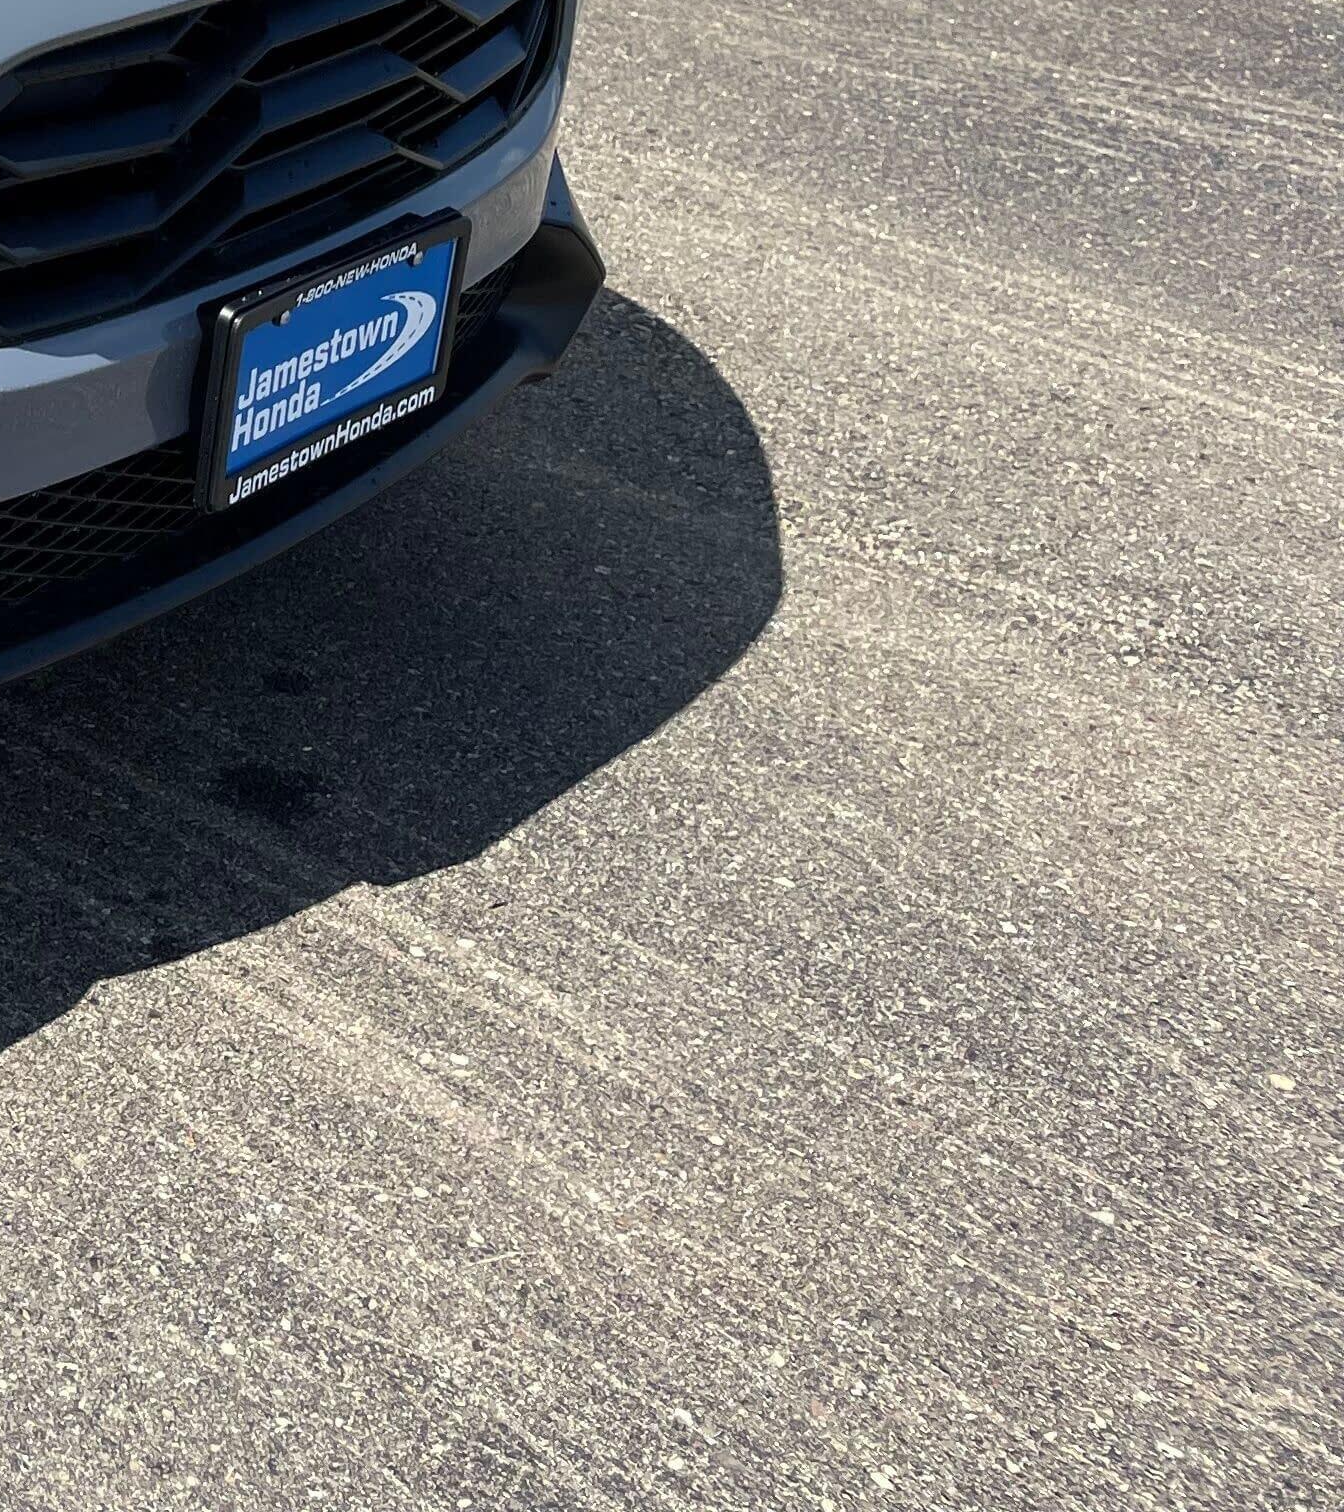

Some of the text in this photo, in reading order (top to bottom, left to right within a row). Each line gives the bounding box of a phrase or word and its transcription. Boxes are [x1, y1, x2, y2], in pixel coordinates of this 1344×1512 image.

[295, 242, 418, 307] 1-800-NEW-HONDA
[238, 310, 399, 410] Jamestown
[229, 385, 435, 505] JamestownHonda.com
[231, 381, 321, 452] Honda
